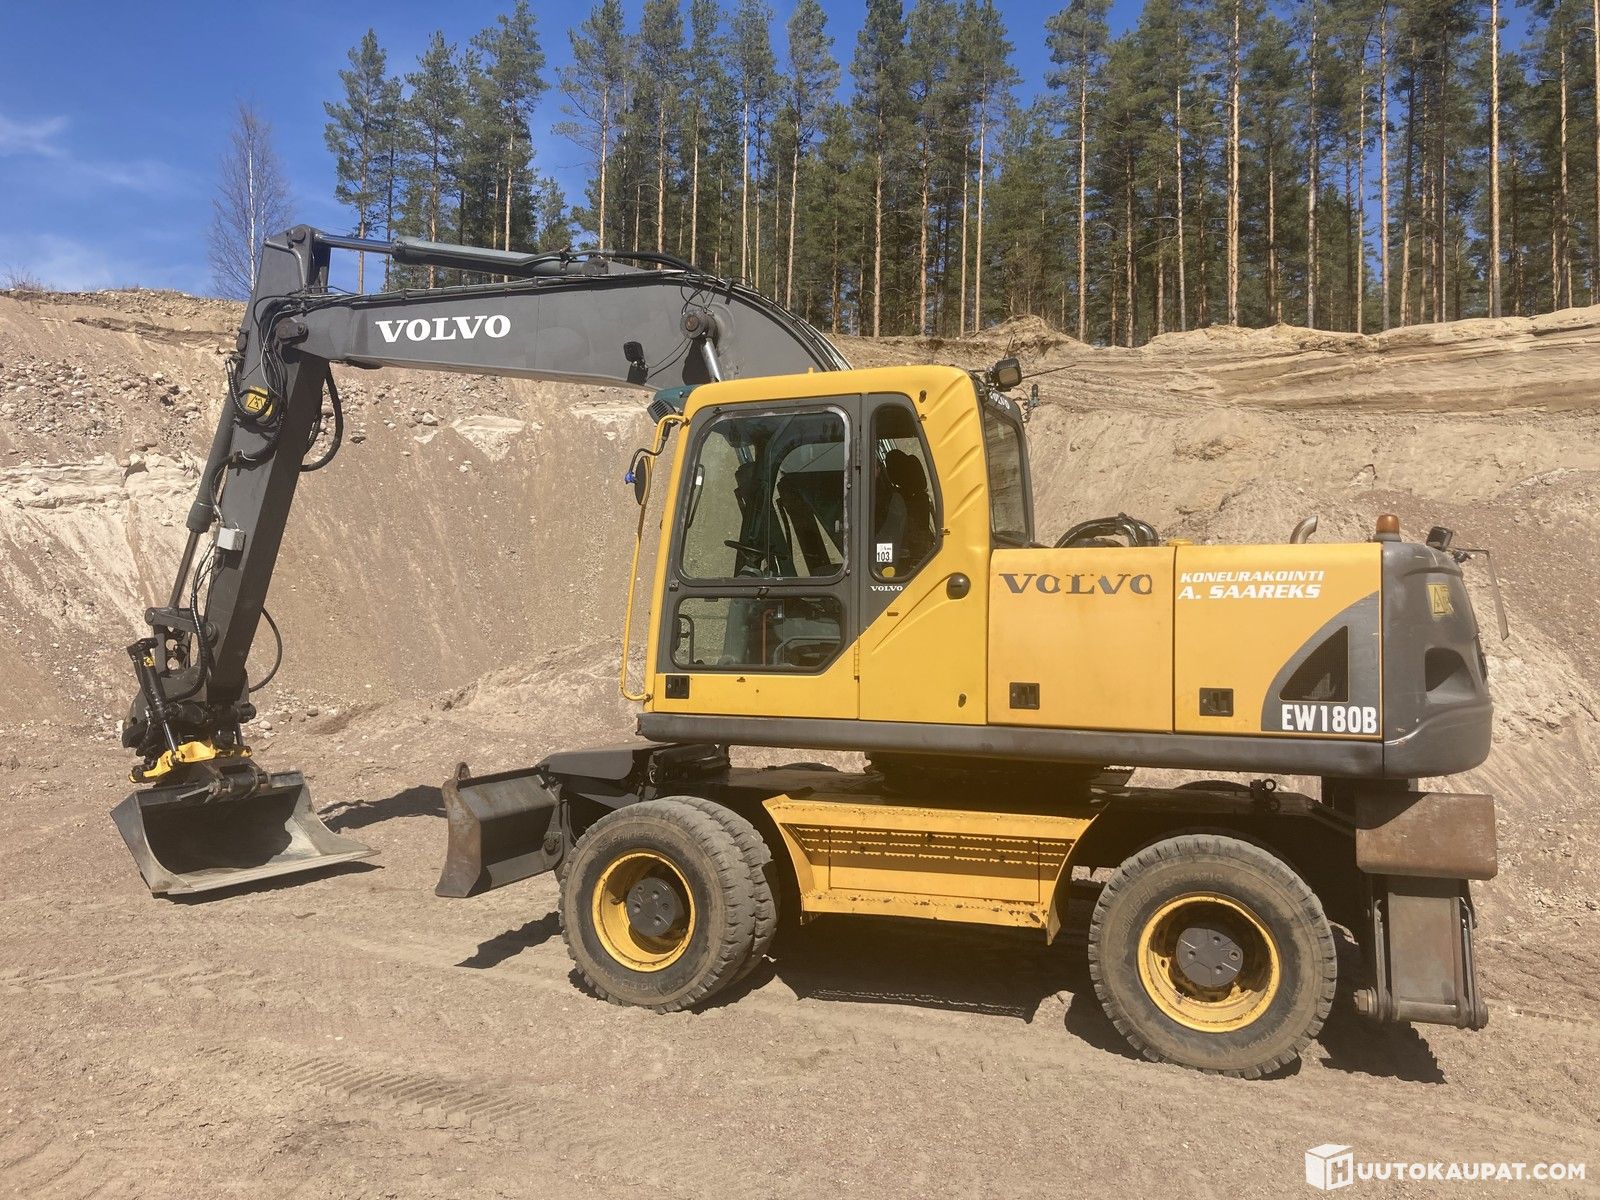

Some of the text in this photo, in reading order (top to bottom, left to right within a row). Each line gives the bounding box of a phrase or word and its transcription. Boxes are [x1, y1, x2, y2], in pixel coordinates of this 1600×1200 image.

[375, 314, 511, 343] VOLVO
[998, 574, 1152, 595] VOLVO
[1180, 571, 1325, 583] KONEURAKOINTI
[1178, 584, 1321, 600] A. SAAREKS
[1282, 704, 1377, 734] EW180B
